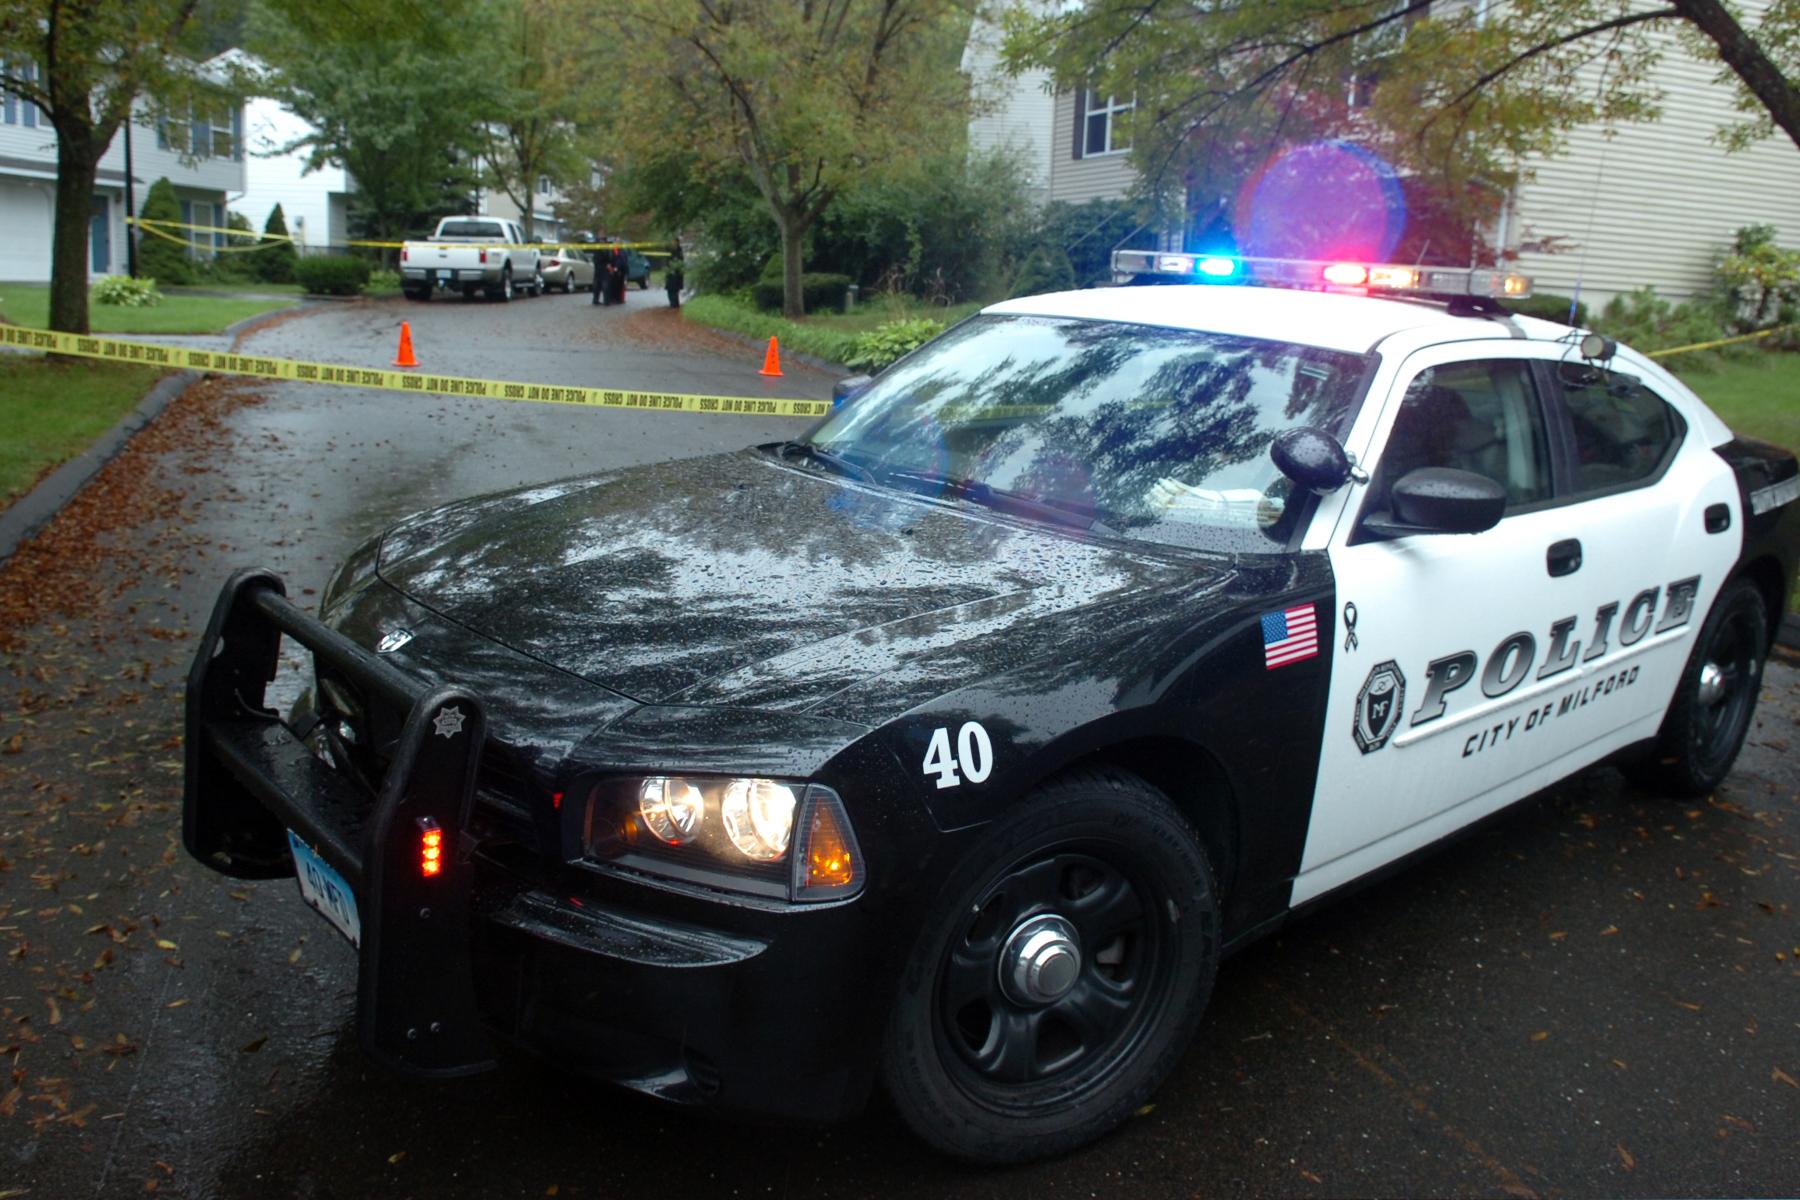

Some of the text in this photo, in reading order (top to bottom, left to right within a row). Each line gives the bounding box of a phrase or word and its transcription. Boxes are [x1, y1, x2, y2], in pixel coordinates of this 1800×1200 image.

[78, 337, 168, 362] POLICE LINE DO NOT CROSS
[189, 352, 277, 375] POLICE LINE DO NOT CROSS
[297, 364, 384, 386] POLICE LINE DO NOT CROSS
[402, 375, 486, 395] POLICE LINE DO NOT CROSS
[504, 384, 586, 403] POLICE LINE DO NOT CROSS
[603, 392, 683, 409] POLICE LINE DO NOT CROSS
[700, 398, 776, 413] POLICE LINE DO NOT CROSS
[793, 402, 811, 414] CROSS
[814, 403, 825, 414] NOT
[1410, 574, 1702, 728] POLICE
[1462, 665, 1640, 758] CITY OF MILFORD
[922, 721, 993, 789] 40
